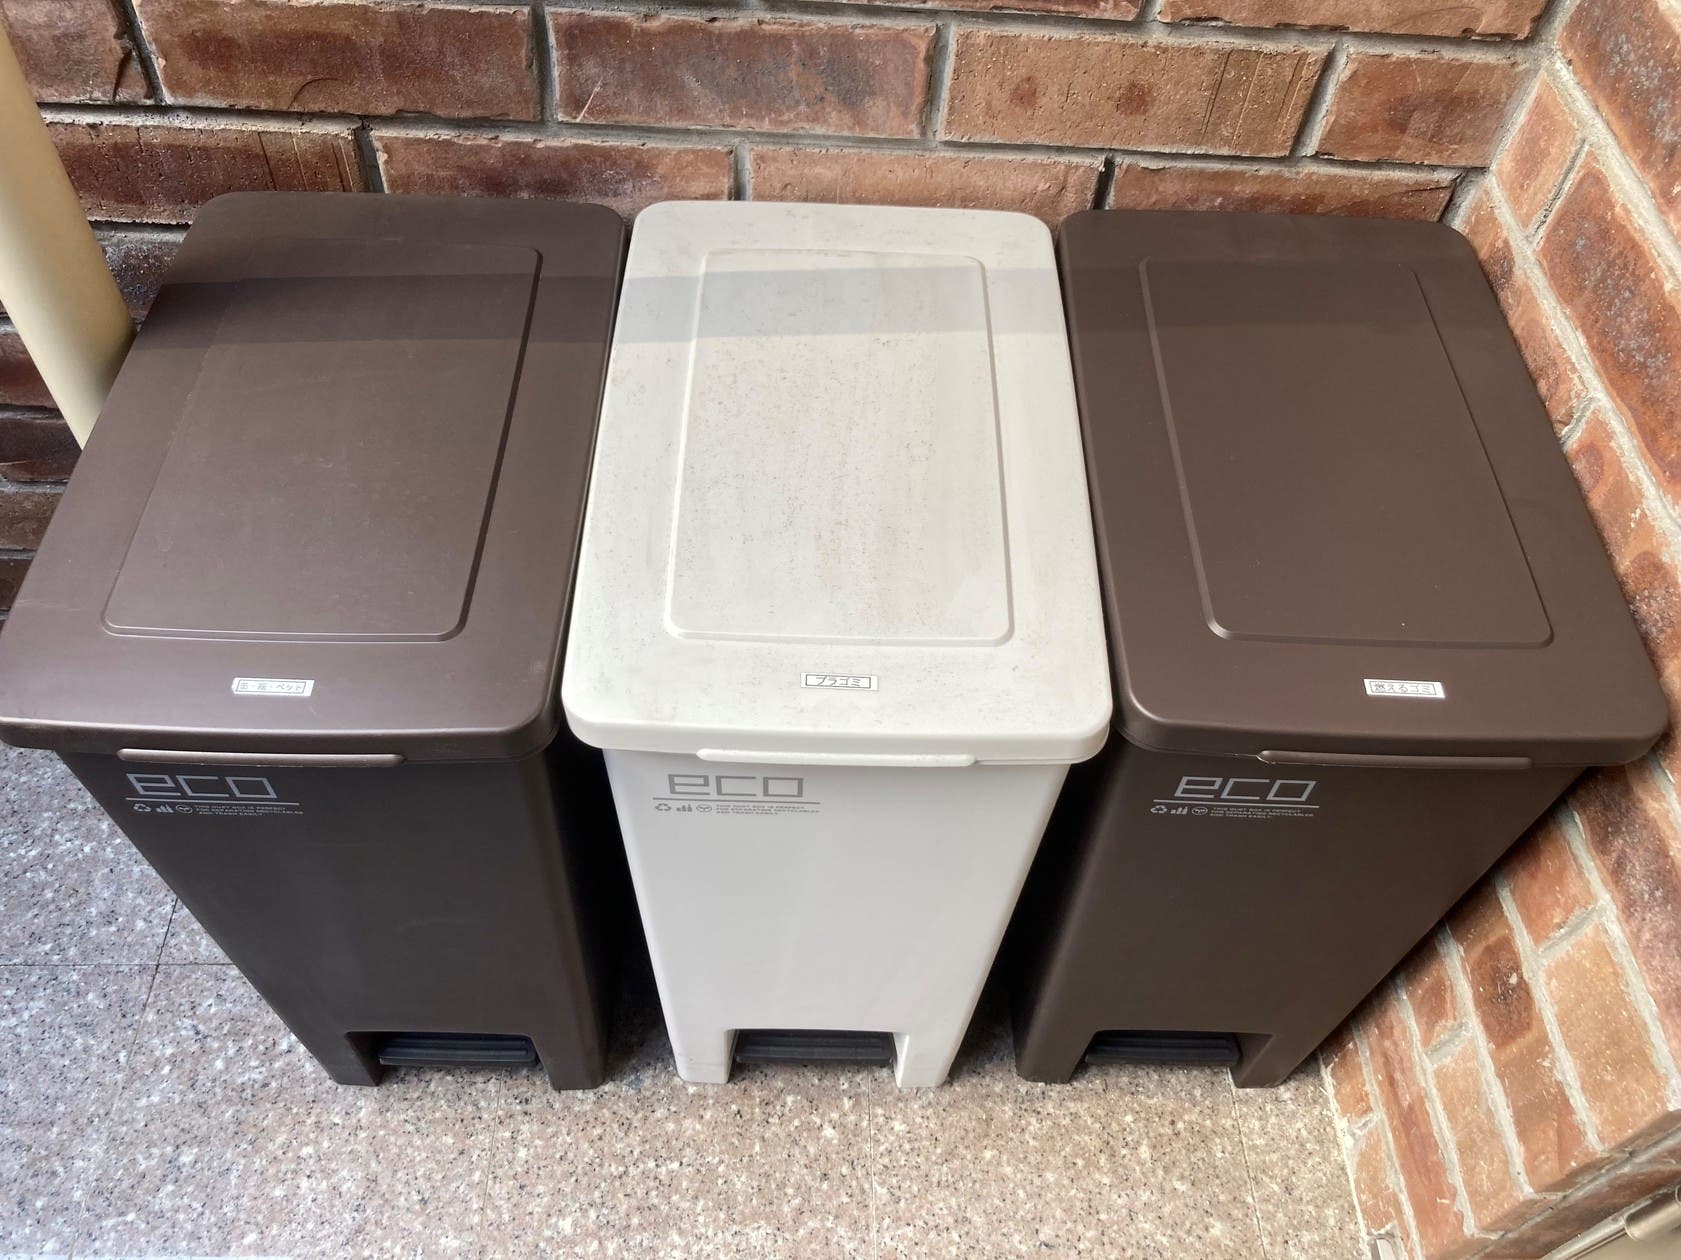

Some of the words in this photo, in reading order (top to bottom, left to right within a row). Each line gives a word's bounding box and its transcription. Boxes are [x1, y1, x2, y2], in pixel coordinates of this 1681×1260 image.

[815, 675, 862, 687] プラゴミ
[1374, 682, 1432, 695] 燃えるゴミ
[126, 773, 278, 799] eco
[668, 773, 804, 798] eco
[1174, 775, 1318, 802] eco
